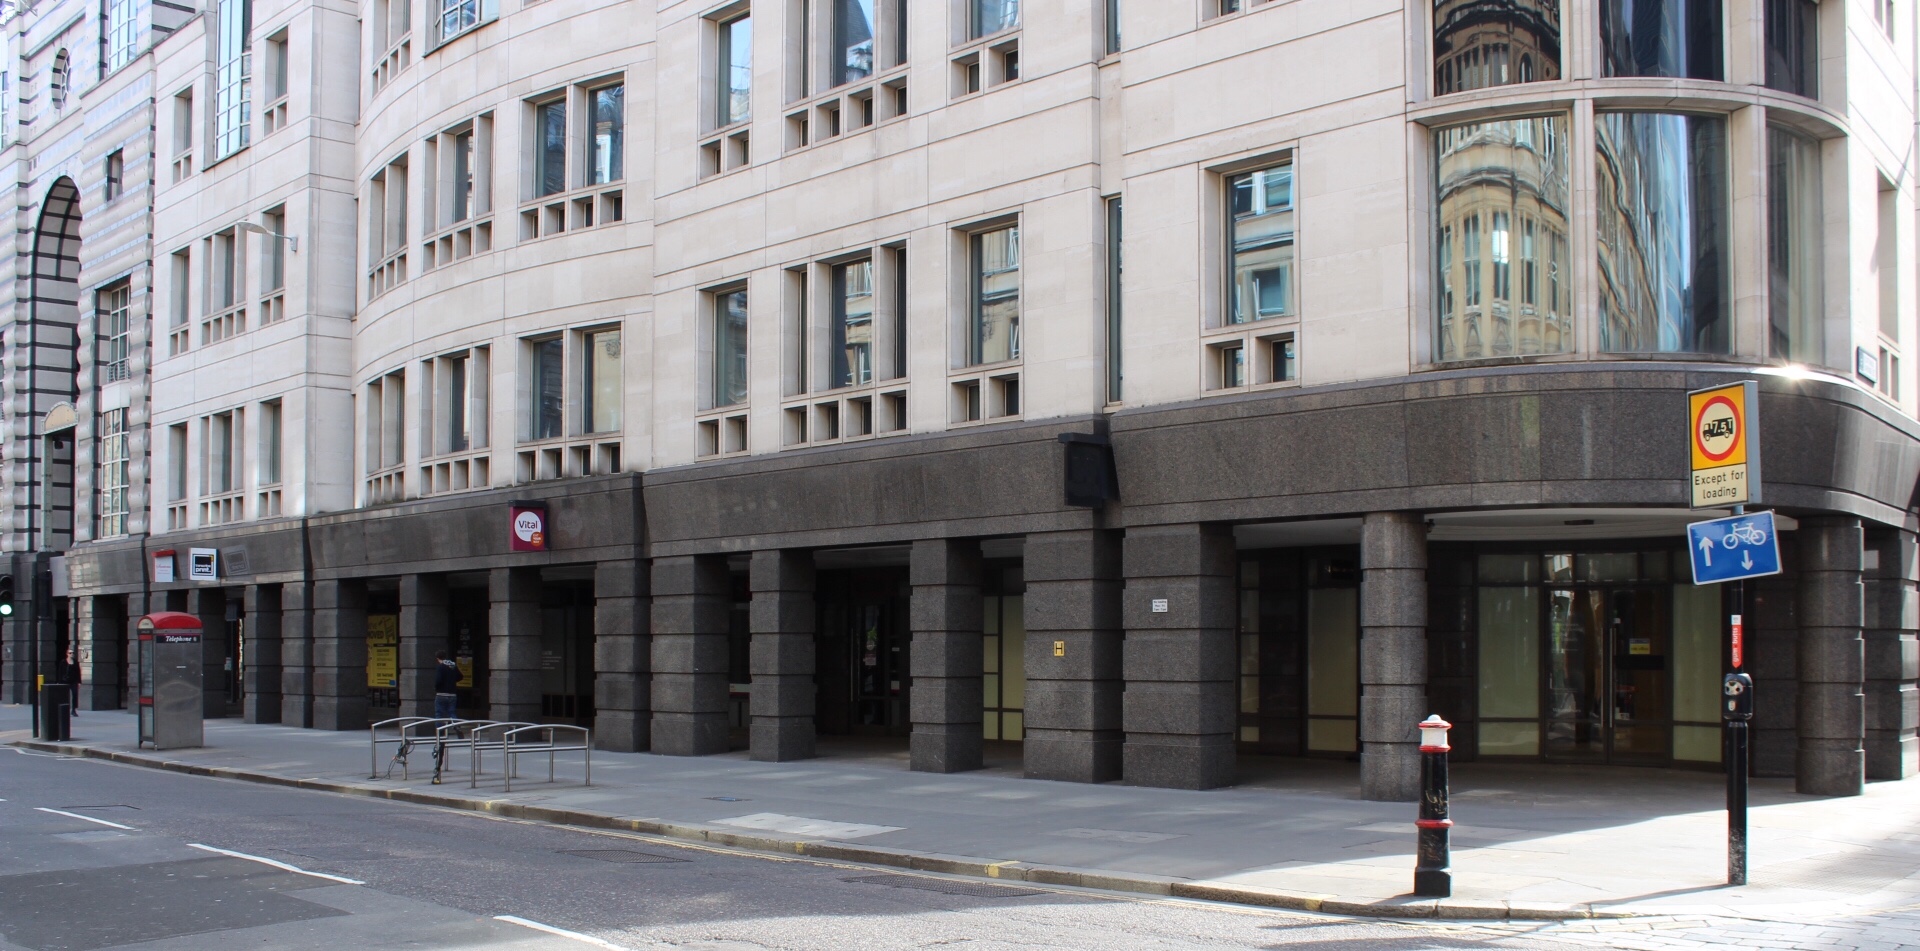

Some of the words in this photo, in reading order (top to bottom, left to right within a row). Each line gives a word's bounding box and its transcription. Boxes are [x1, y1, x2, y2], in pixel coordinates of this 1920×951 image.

[1694, 472, 1727, 486] Except
[1730, 470, 1745, 480] for
[1702, 486, 1737, 499] loading
[518, 520, 538, 529] Vital
[165, 635, 192, 643] Telephone
[1055, 642, 1063, 655] H
